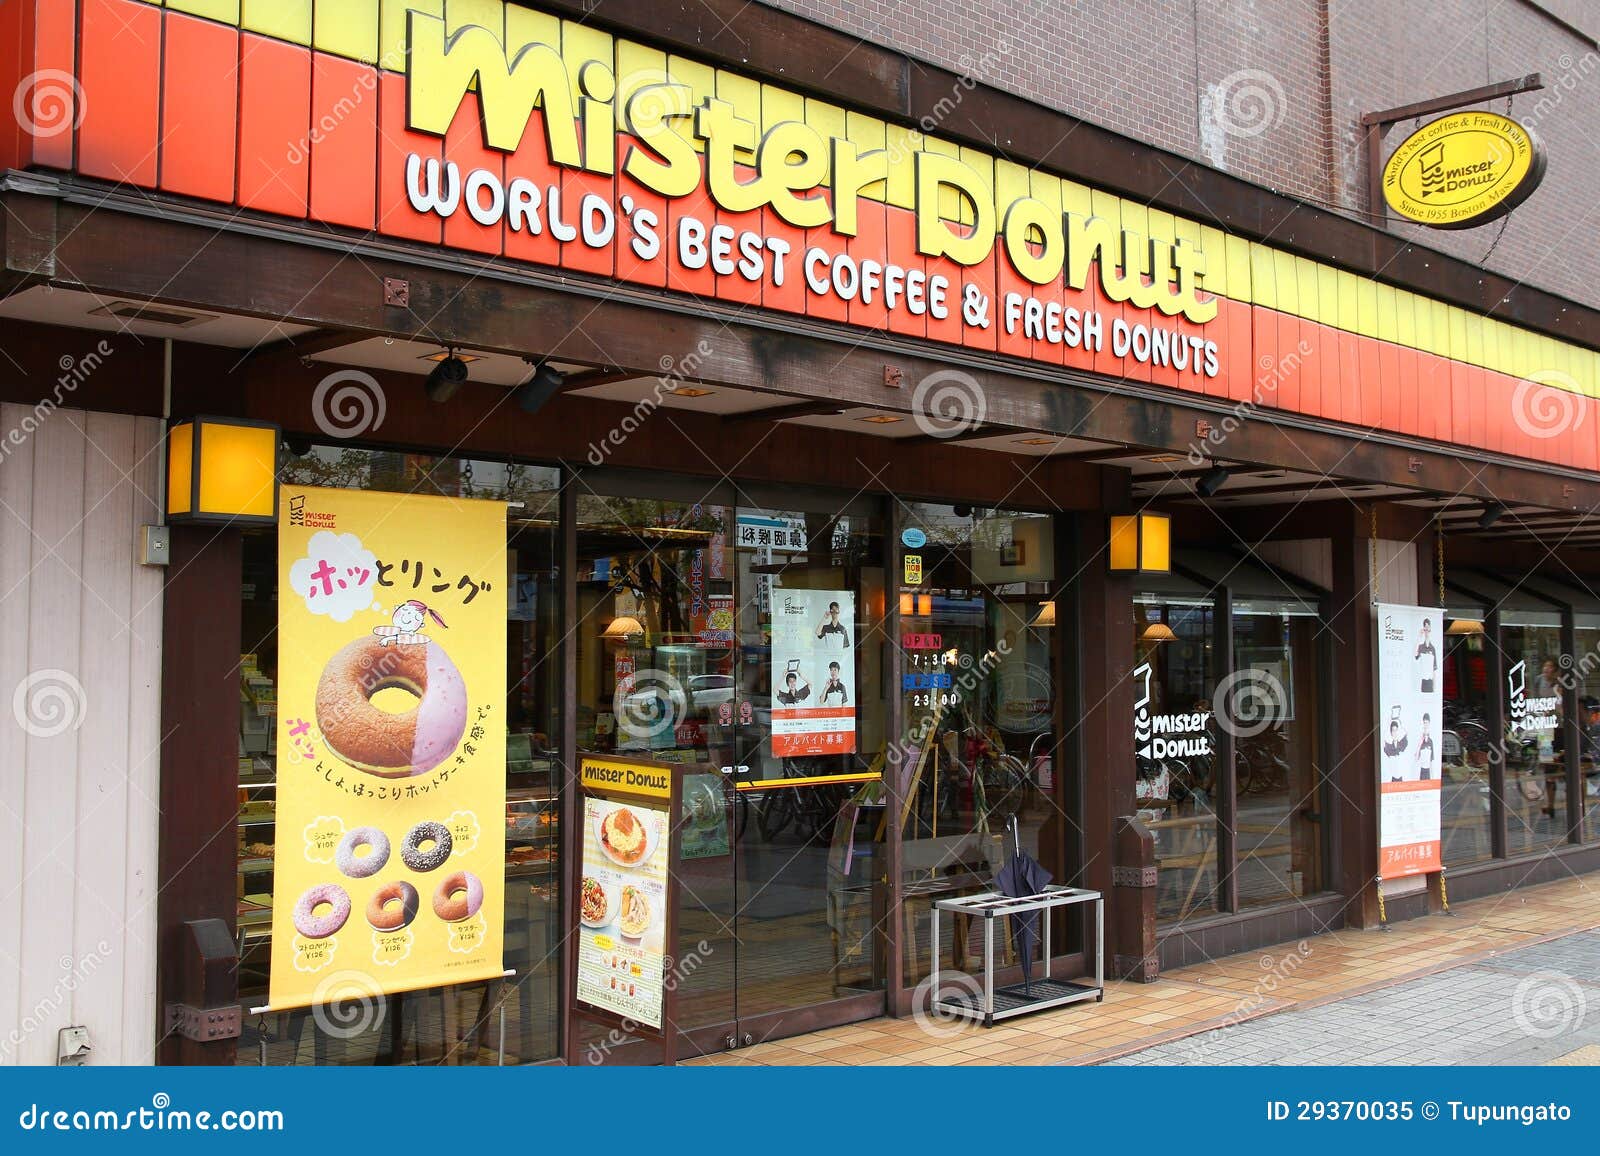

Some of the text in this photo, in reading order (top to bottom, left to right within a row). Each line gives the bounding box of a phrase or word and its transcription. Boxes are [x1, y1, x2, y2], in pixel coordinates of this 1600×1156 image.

[1407, 133, 1426, 151] best
[1428, 121, 1459, 137] coffee
[1461, 117, 1469, 127] &
[1474, 116, 1500, 129] Fresh
[1446, 173, 1496, 192] Donut
[1400, 200, 1425, 218] Since
[1426, 209, 1448, 219] 1955
[1450, 201, 1486, 219] Boston
[914, 150, 1218, 324] Donut
[406, 153, 1219, 378] WORLD'S BEST COFFEE & FRESH DONUTS
[914, 694, 957, 707] 23:00
[1153, 736, 1212, 759] Donut
[626, 770, 668, 789] Donut
